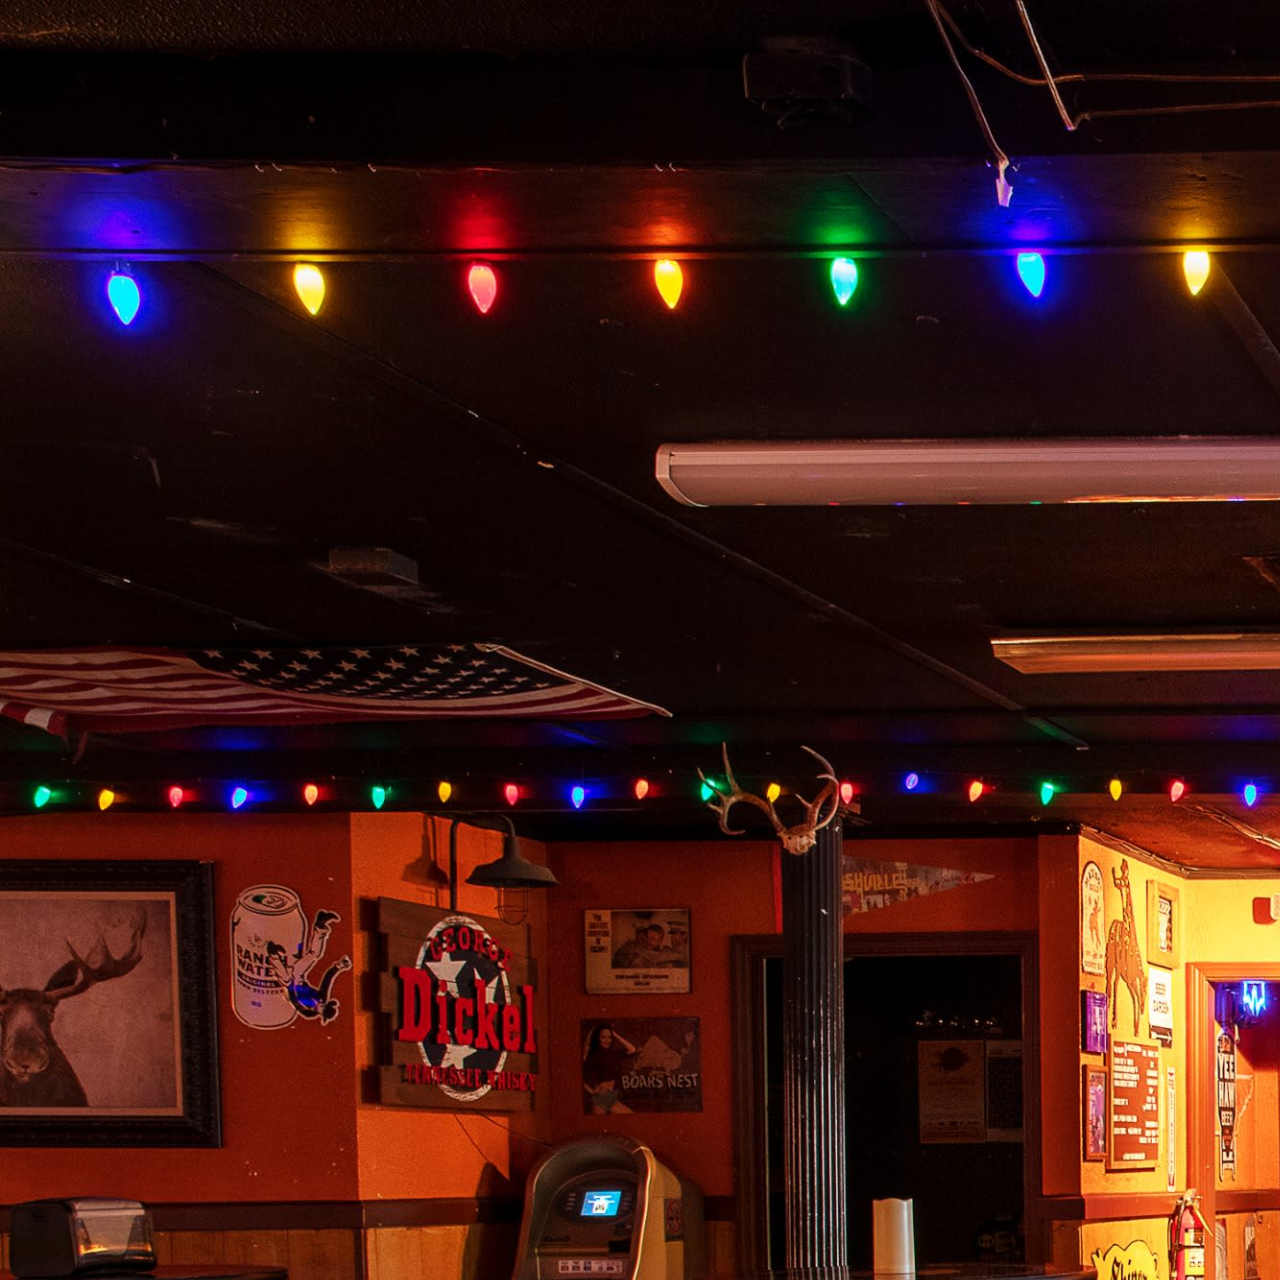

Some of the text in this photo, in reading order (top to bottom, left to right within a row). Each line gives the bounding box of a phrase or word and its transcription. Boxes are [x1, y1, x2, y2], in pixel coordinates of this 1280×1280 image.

[431, 927, 513, 971] GEORGE
[237, 959, 277, 977] WATE
[397, 966, 537, 1053] Dickel
[404, 1063, 538, 1091] TENNESSEE WHISKY
[1218, 1053, 1236, 1079] YEE
[667, 1073, 699, 1088] NEST
[1218, 1081, 1236, 1109] HAW
